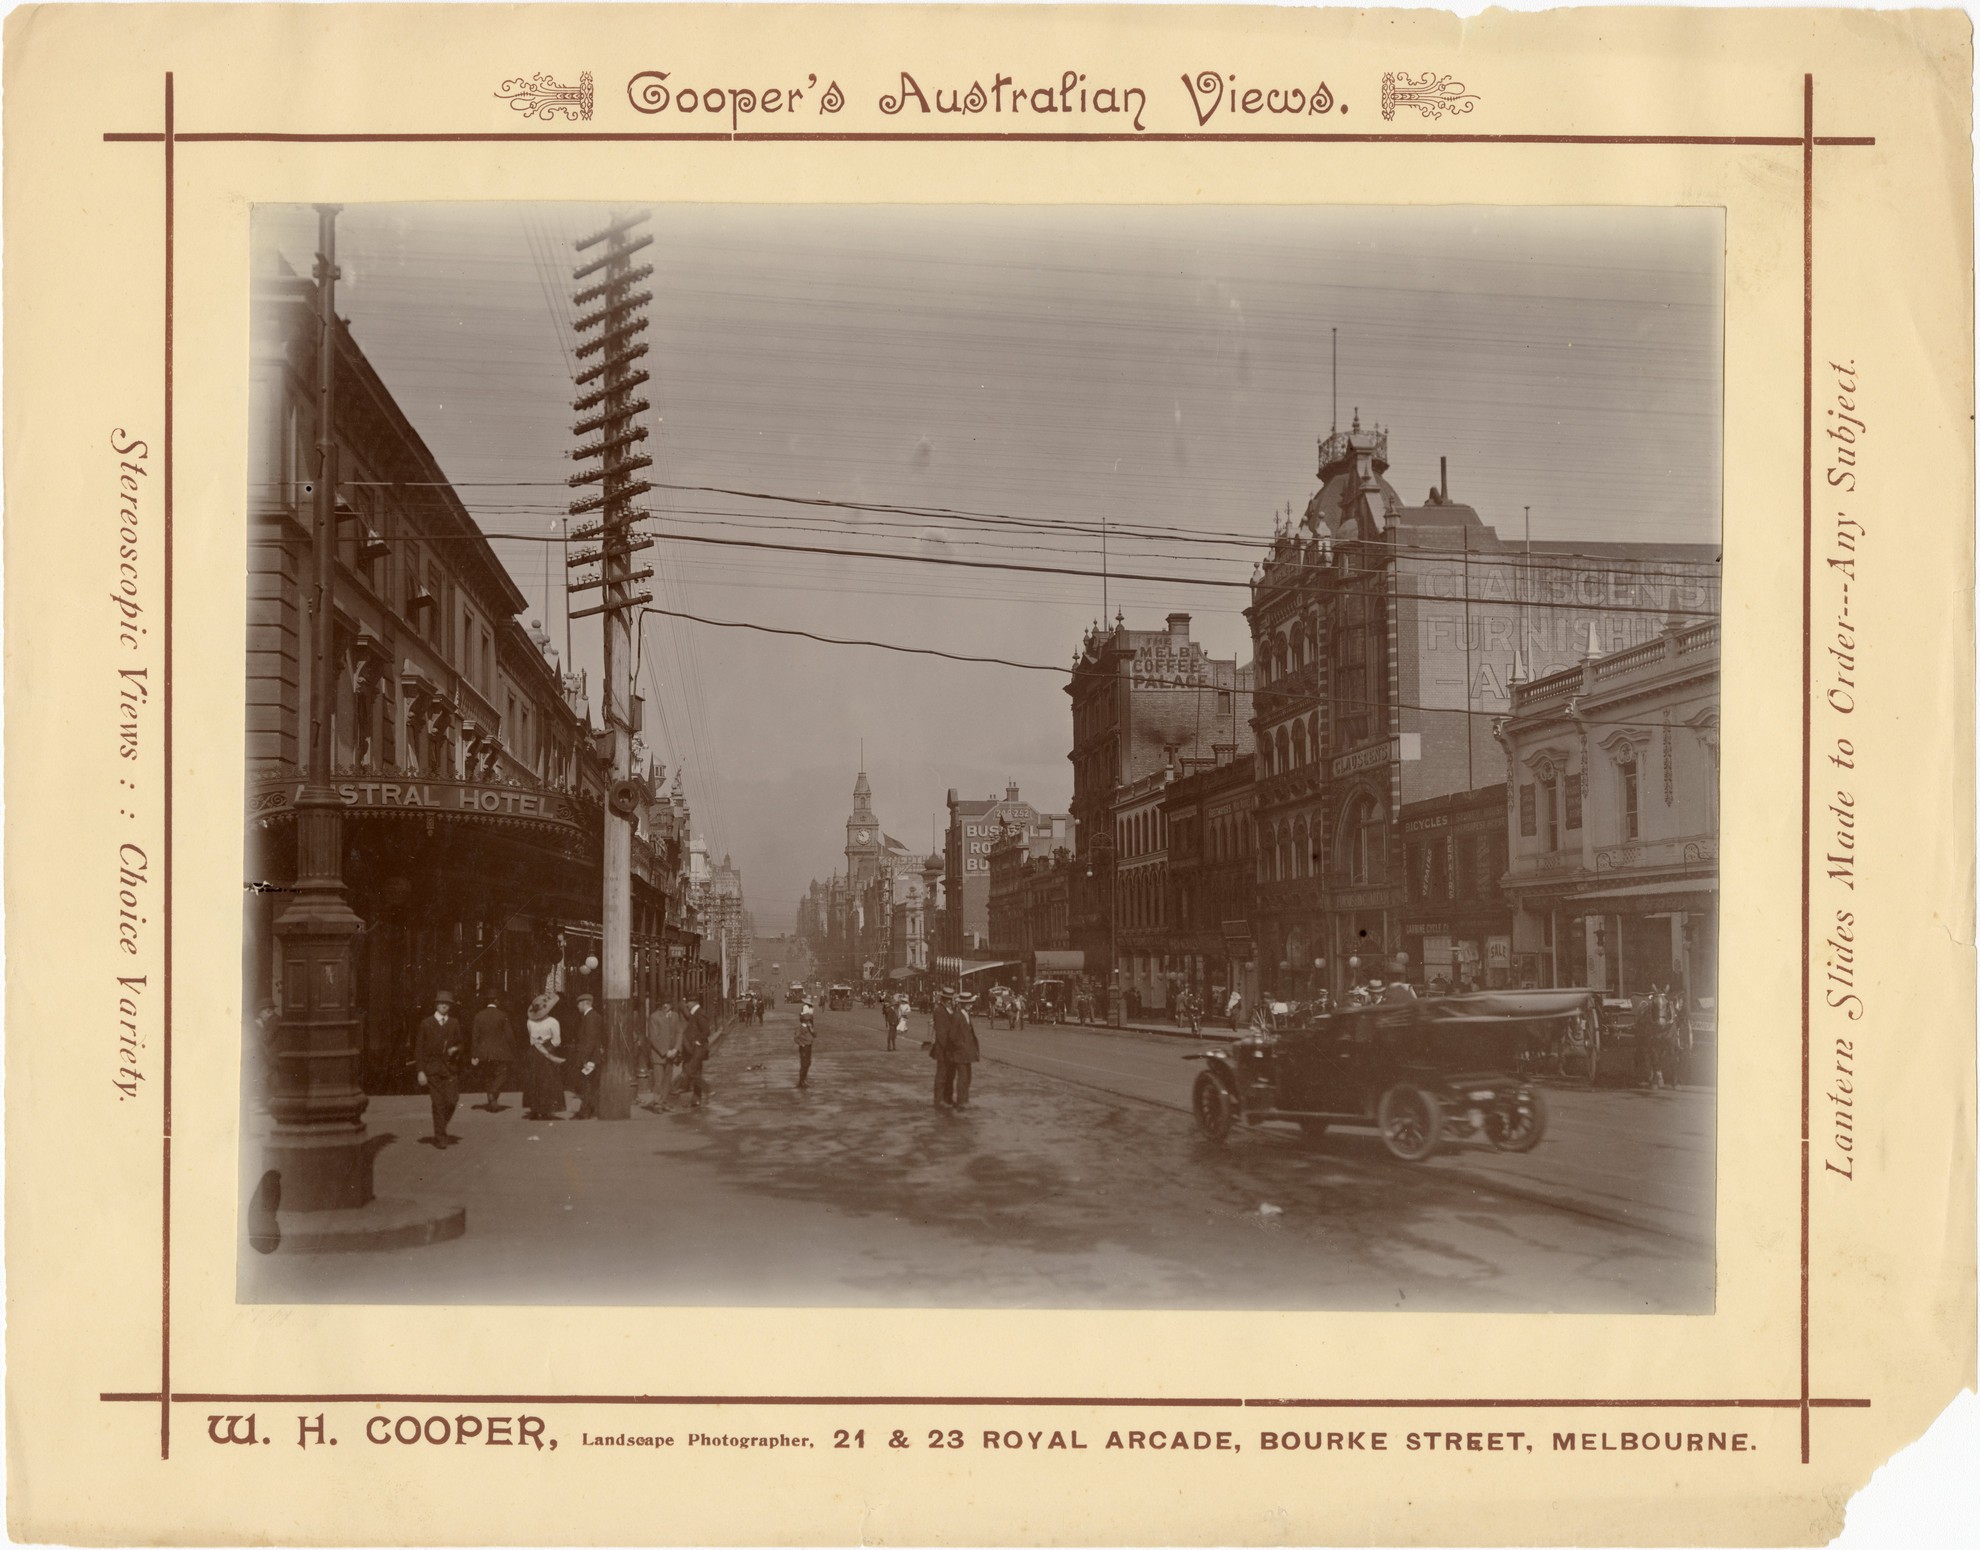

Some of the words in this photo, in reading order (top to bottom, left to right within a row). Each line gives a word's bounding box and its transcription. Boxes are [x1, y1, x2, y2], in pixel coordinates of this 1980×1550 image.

[627, 71, 846, 129] Cooper's
[878, 71, 1146, 130] Australian
[1181, 71, 1349, 126] Views.
[1827, 360, 1867, 492] Subject.
[110, 428, 148, 649] Stereoscopic
[1426, 614, 1703, 652] FURNISHI
[1132, 659, 1201, 673] COFFEE
[1133, 674, 1207, 689] PALACE
[118, 668, 148, 760] Views
[1827, 739, 1855, 769] to
[294, 783, 440, 807] STRAL
[458, 788, 555, 819] HOTEL
[1405, 815, 1449, 832] BICYCLES
[1827, 791, 1855, 890] Made
[119, 844, 148, 954] Choice
[1490, 943, 1507, 959] SALE
[1827, 910, 1864, 1020] Slides
[111, 976, 148, 1102] Variety.
[1826, 1039, 1854, 1181] Lantern
[207, 1414, 271, 1446] W.
[297, 1413, 338, 1451] H.
[366, 1414, 558, 1452] COOPER,
[582, 1432, 675, 1449] Landscape
[688, 1433, 815, 1450] Photographer,
[833, 1429, 865, 1449] 21
[888, 1429, 910, 1449] &
[927, 1429, 965, 1450] 23
[983, 1429, 1088, 1450] ROYAL
[1105, 1430, 1241, 1454] ARCADE,
[1261, 1431, 1388, 1451] BOURKE
[1405, 1431, 1533, 1454] STREET,
[1552, 1431, 1757, 1452] MELBOURNE.
